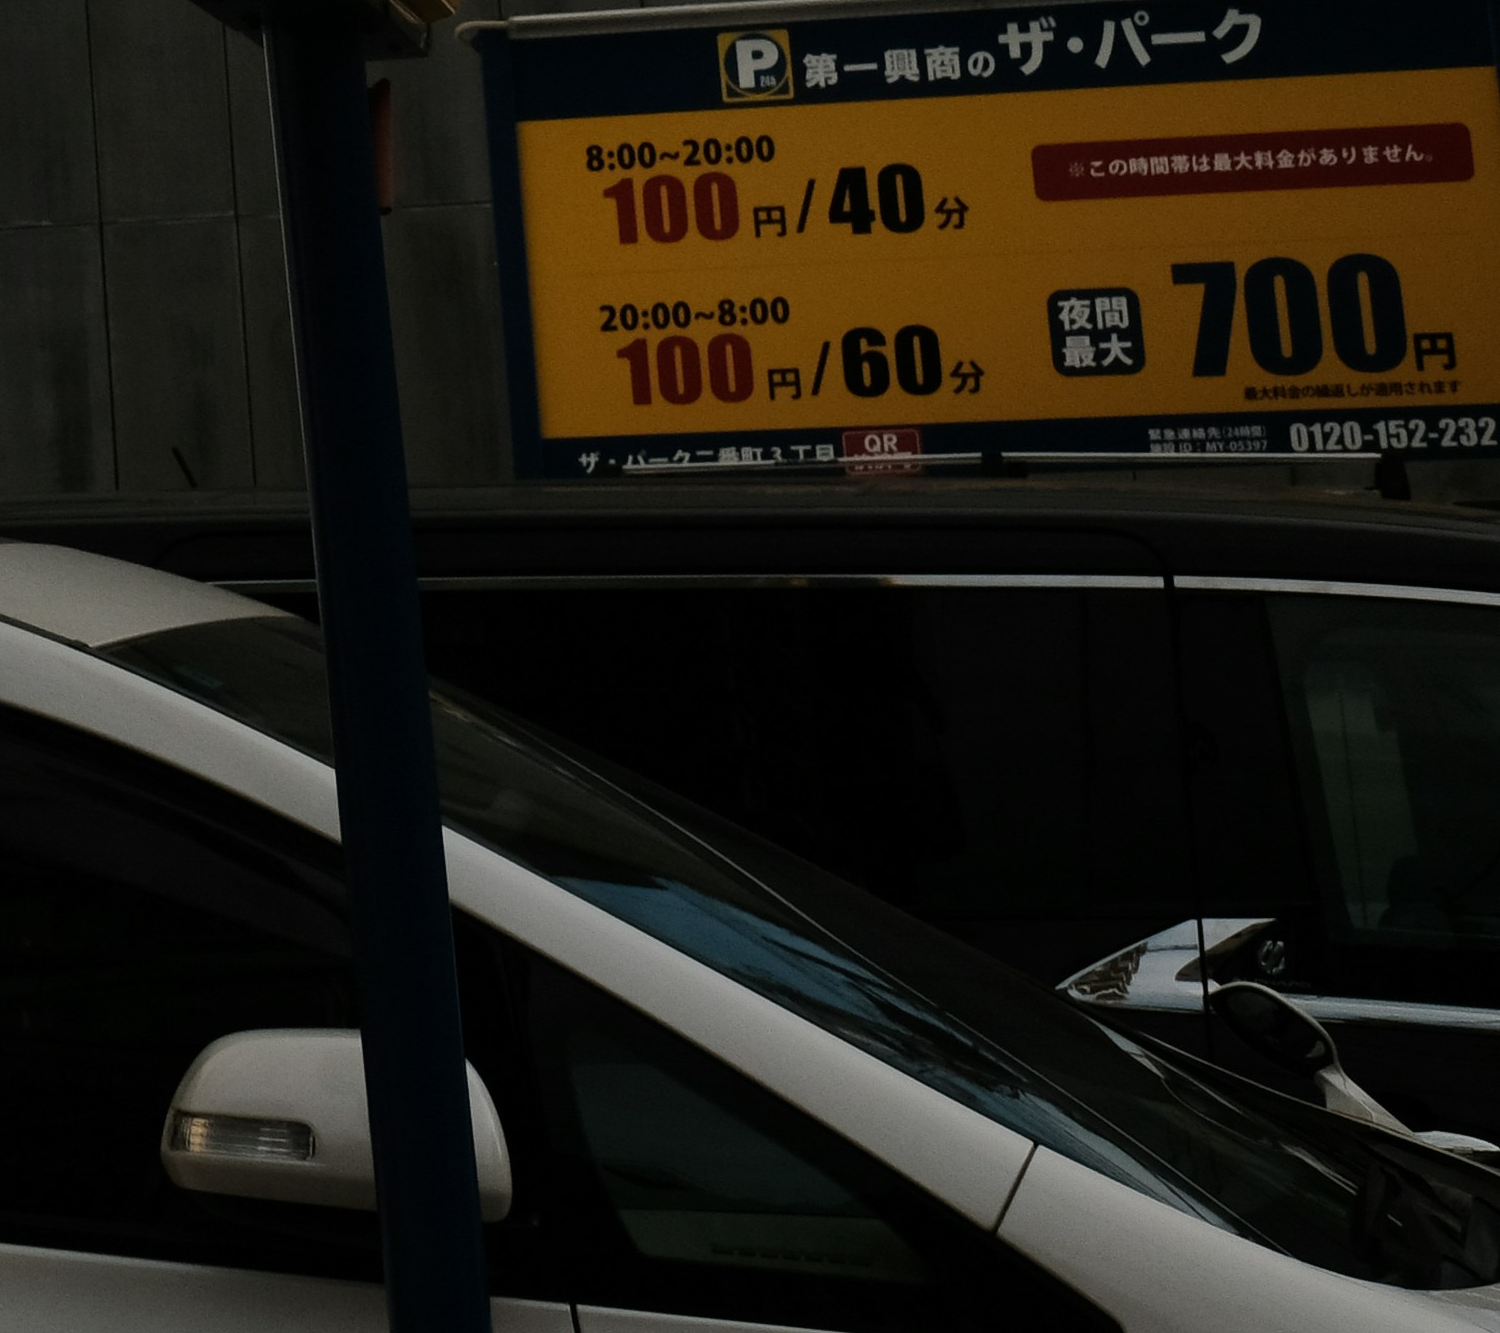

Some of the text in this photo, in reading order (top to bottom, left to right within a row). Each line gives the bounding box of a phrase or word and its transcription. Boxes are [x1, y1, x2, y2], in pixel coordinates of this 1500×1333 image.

[802, 7, 1262, 89] 第一興商のザ・パーク
[1068, 143, 1434, 179] ※この時間帯は最大料金がありません。
[1057, 295, 1130, 332] 夜間
[1170, 252, 1458, 378] 700円
[1062, 333, 1134, 369] 最大
[863, 433, 899, 454] QR
[1289, 417, 1498, 453] 0120-152-232
